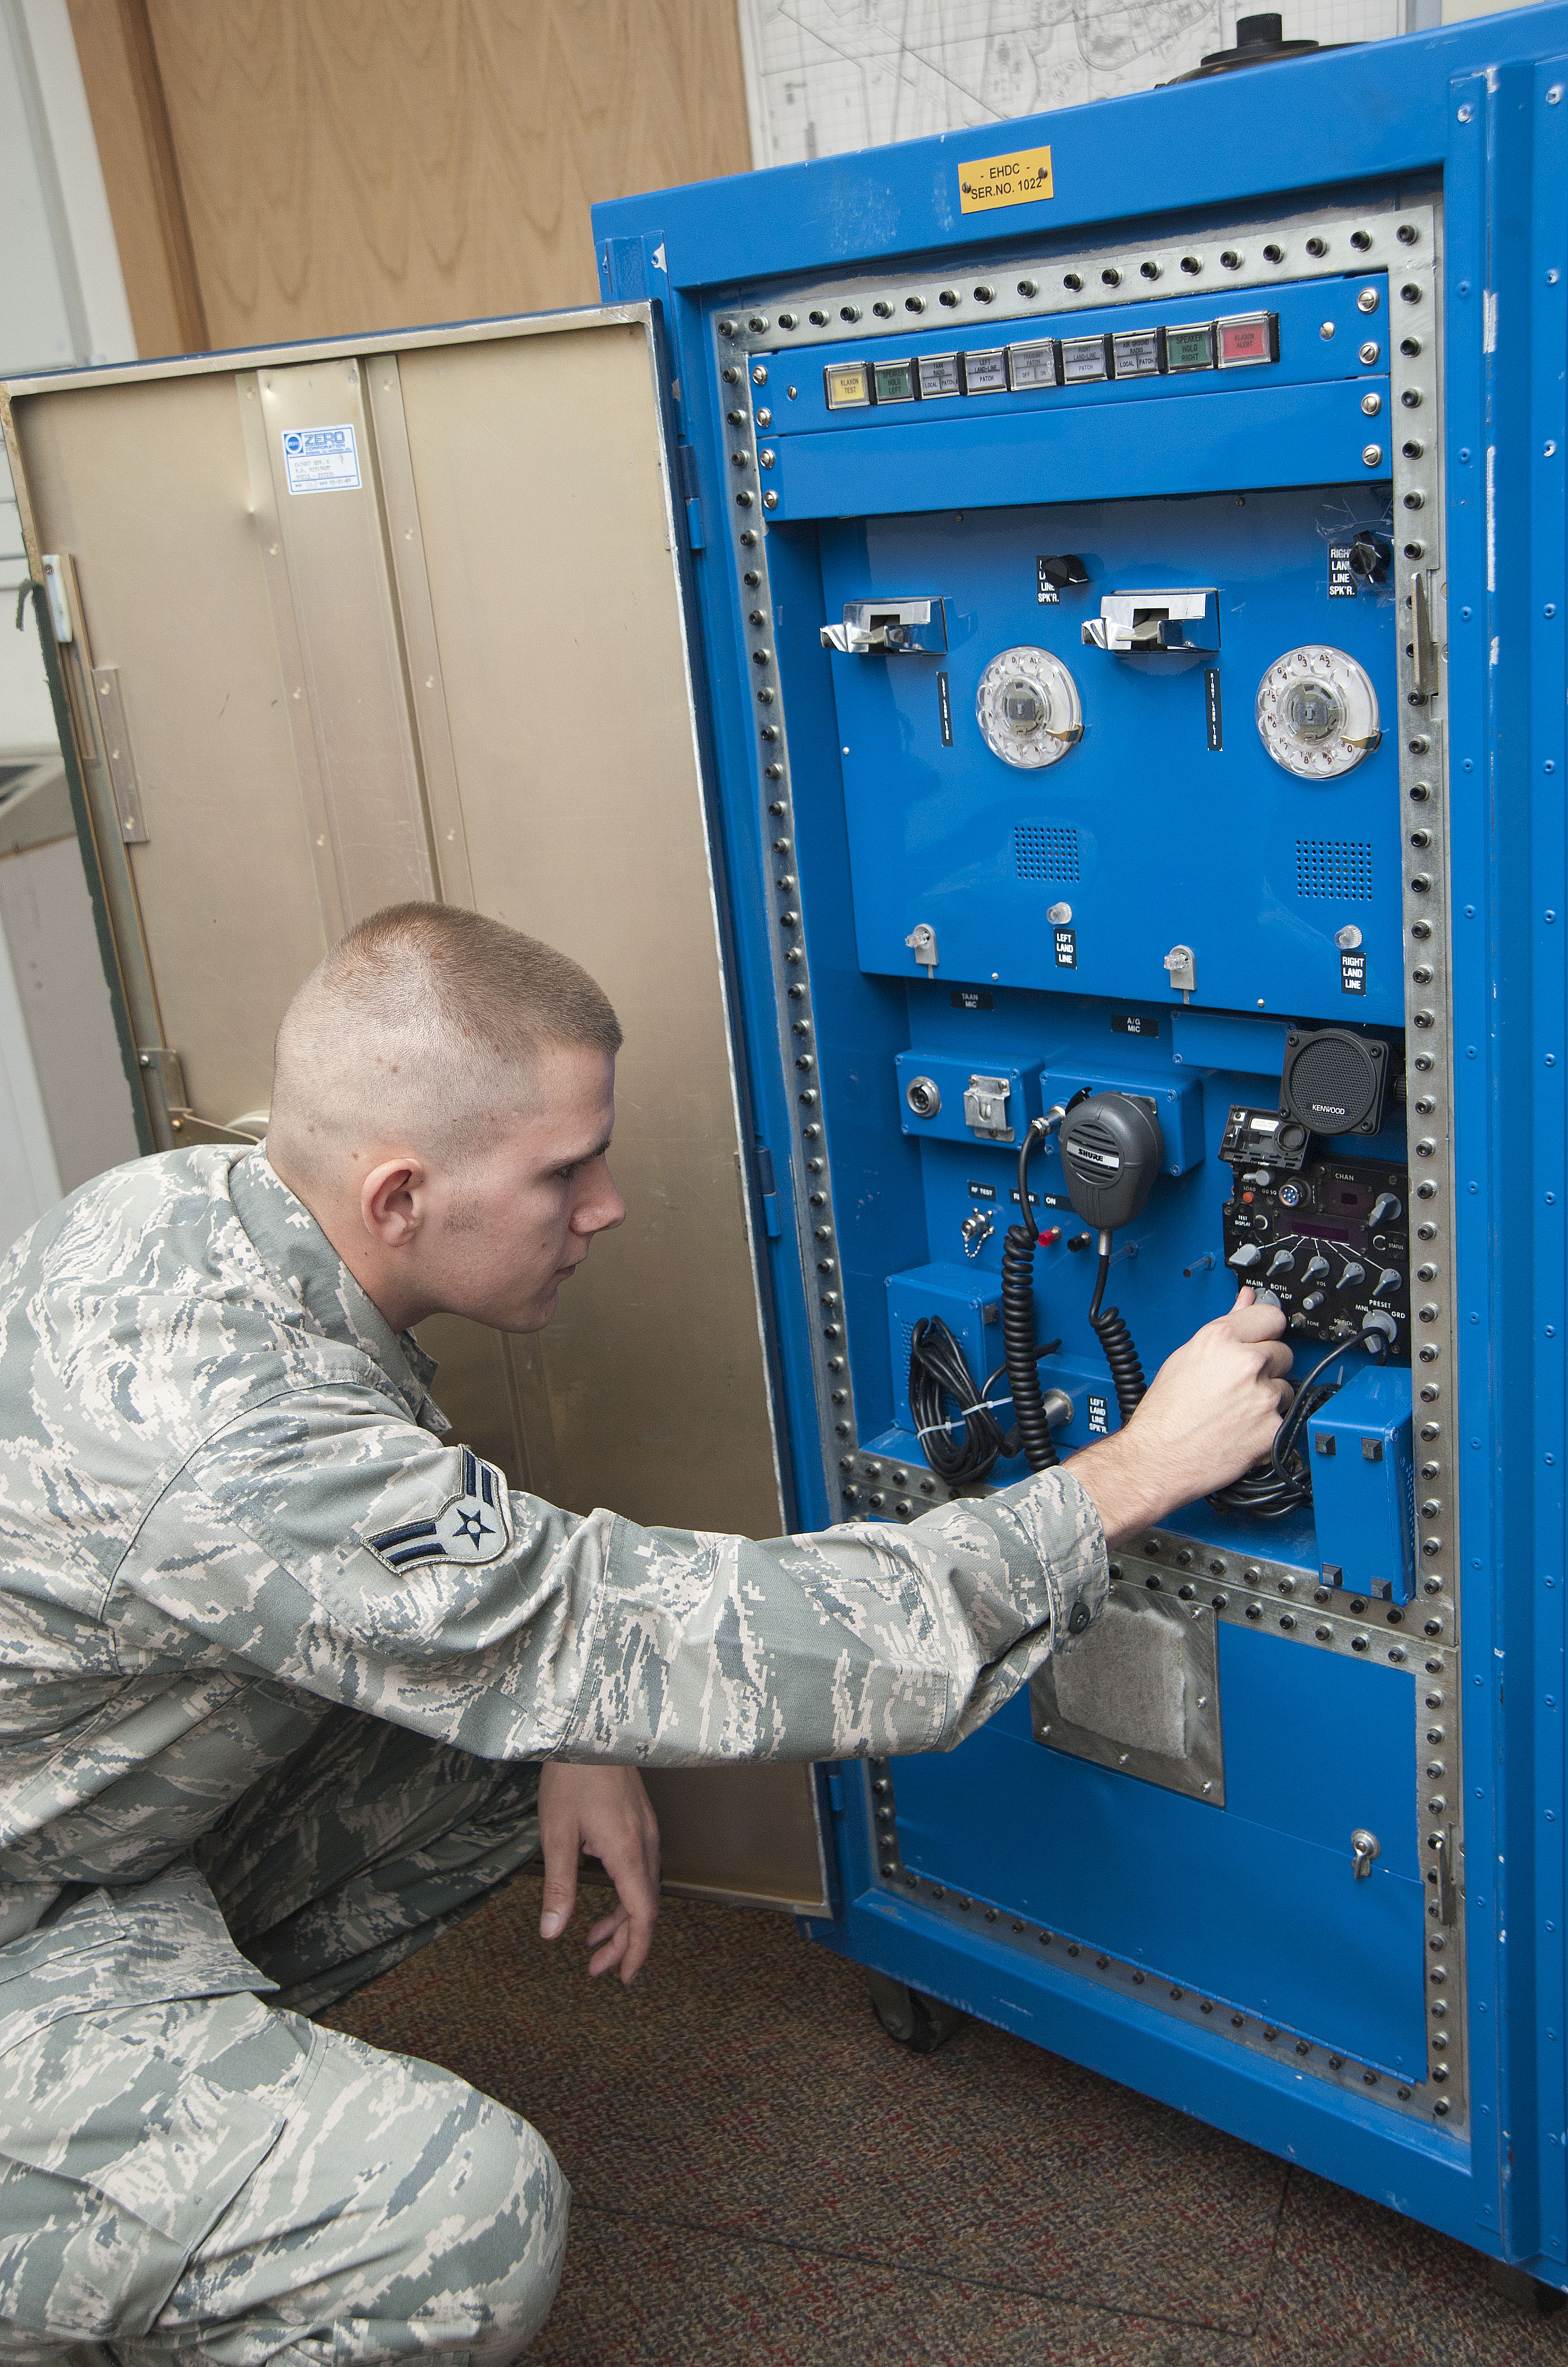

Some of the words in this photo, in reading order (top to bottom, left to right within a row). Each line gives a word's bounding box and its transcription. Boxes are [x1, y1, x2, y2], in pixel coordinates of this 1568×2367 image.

[990, 163, 1020, 179] EHDC
[971, 182, 1014, 199] SER.NO.
[1018, 178, 1042, 191] 1022
[1176, 335, 1202, 344] SPEAKER
[1182, 353, 1199, 362] RIGHT
[882, 370, 904, 378] SPEAKER
[304, 431, 345, 446] ZERO
[1332, 573, 1349, 583] LINE
[1041, 582, 1055, 591] LINE
[1329, 586, 1355, 595] SPK'R.
[1037, 593, 1059, 603] SPK'R.
[1057, 933, 1072, 943] LEFT
[1056, 942, 1074, 953] LAND
[1058, 954, 1073, 964] LINE
[1342, 956, 1365, 967] RIGHT
[1343, 967, 1363, 978] LAND
[1345, 979, 1361, 990] LINE
[1312, 1104, 1345, 1115] KENWOOD
[1078, 1148, 1103, 1162] SHURE
[1046, 1197, 1056, 1205] ON
[1246, 1278, 1263, 1287] MAIN
[1270, 1283, 1287, 1291] BOTH
[1355, 1304, 1369, 1312] MNL
[1369, 1299, 1391, 1309] PRESET
[1334, 1318, 1352, 1327] SQUELCH
[1090, 1397, 1104, 1408] LEFT
[1090, 1406, 1106, 1416] LAND
[1091, 1415, 1105, 1425] LINE
